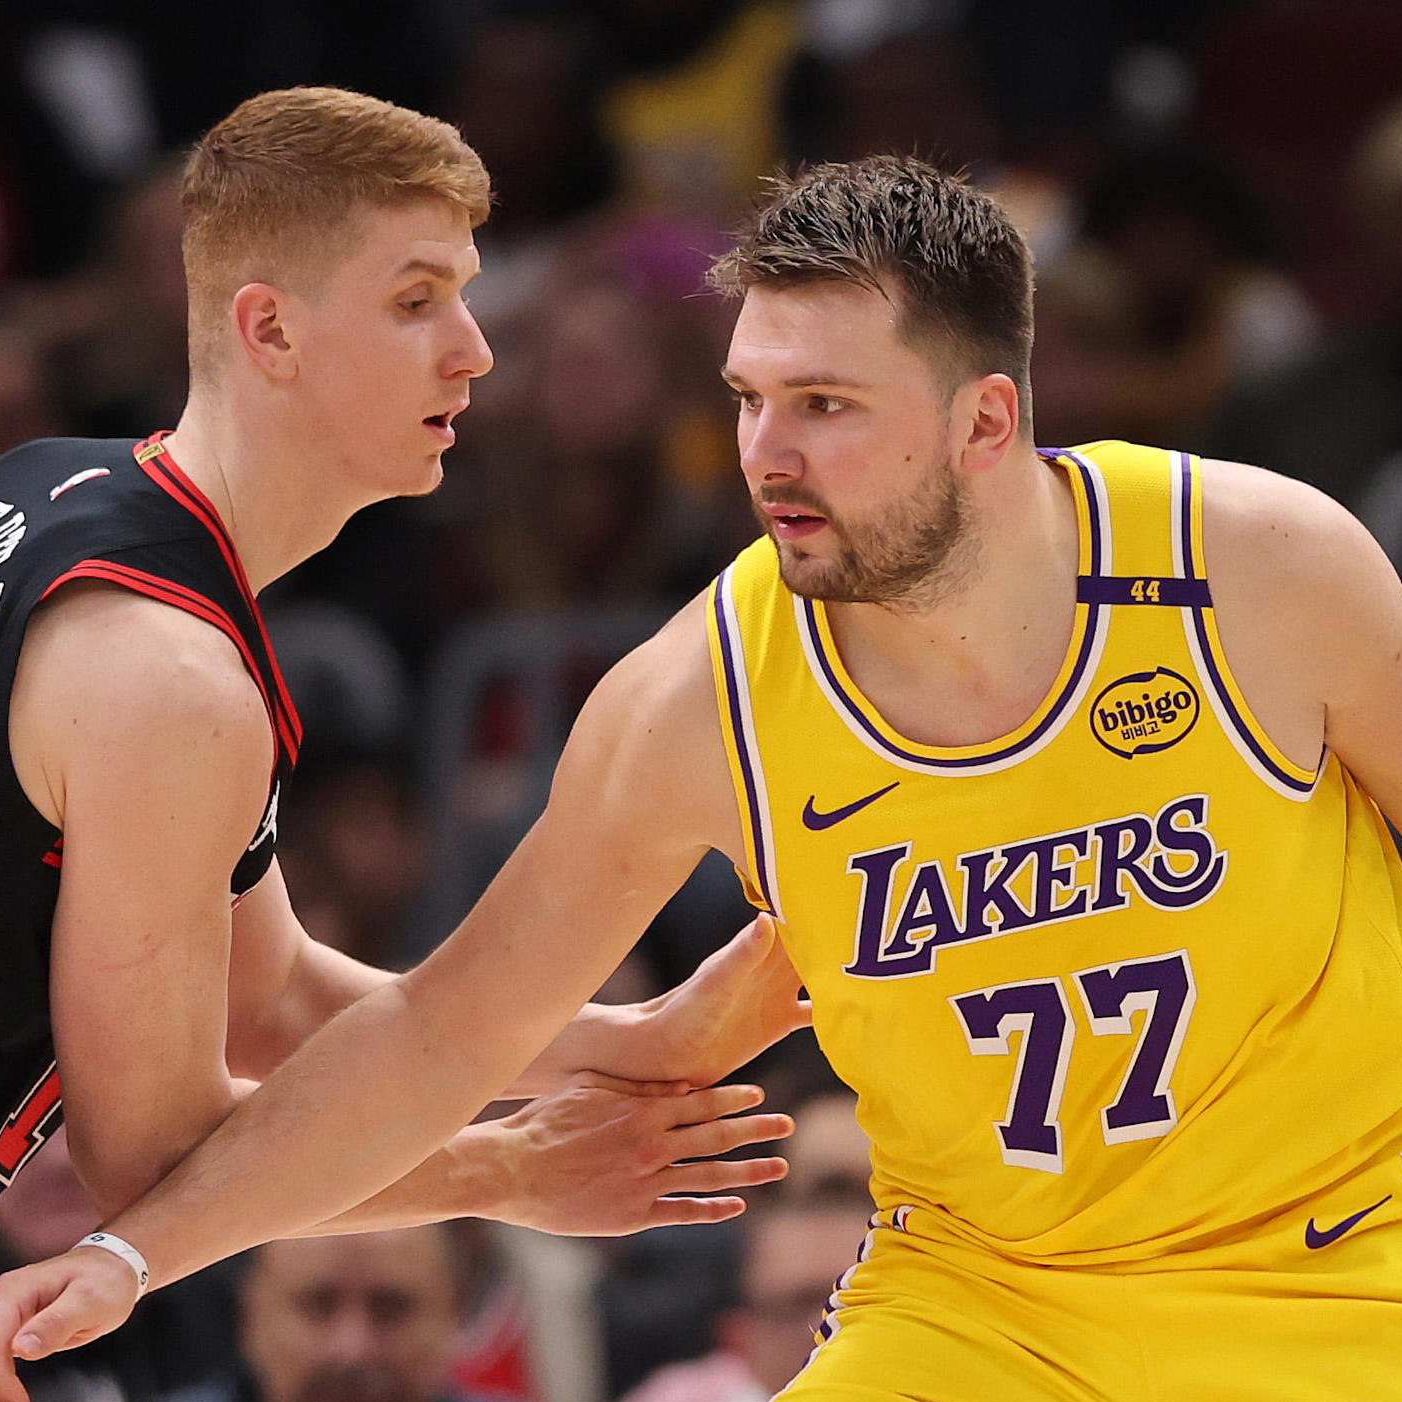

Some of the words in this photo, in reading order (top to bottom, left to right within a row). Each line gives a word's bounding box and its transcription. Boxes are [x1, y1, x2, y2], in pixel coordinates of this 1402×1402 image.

[1130, 579, 1161, 602] 44
[1098, 690, 1192, 732] bibigo
[1121, 720, 1161, 741] 비비고
[841, 793, 1229, 981] LAKERS
[947, 948, 1199, 1175] 77
